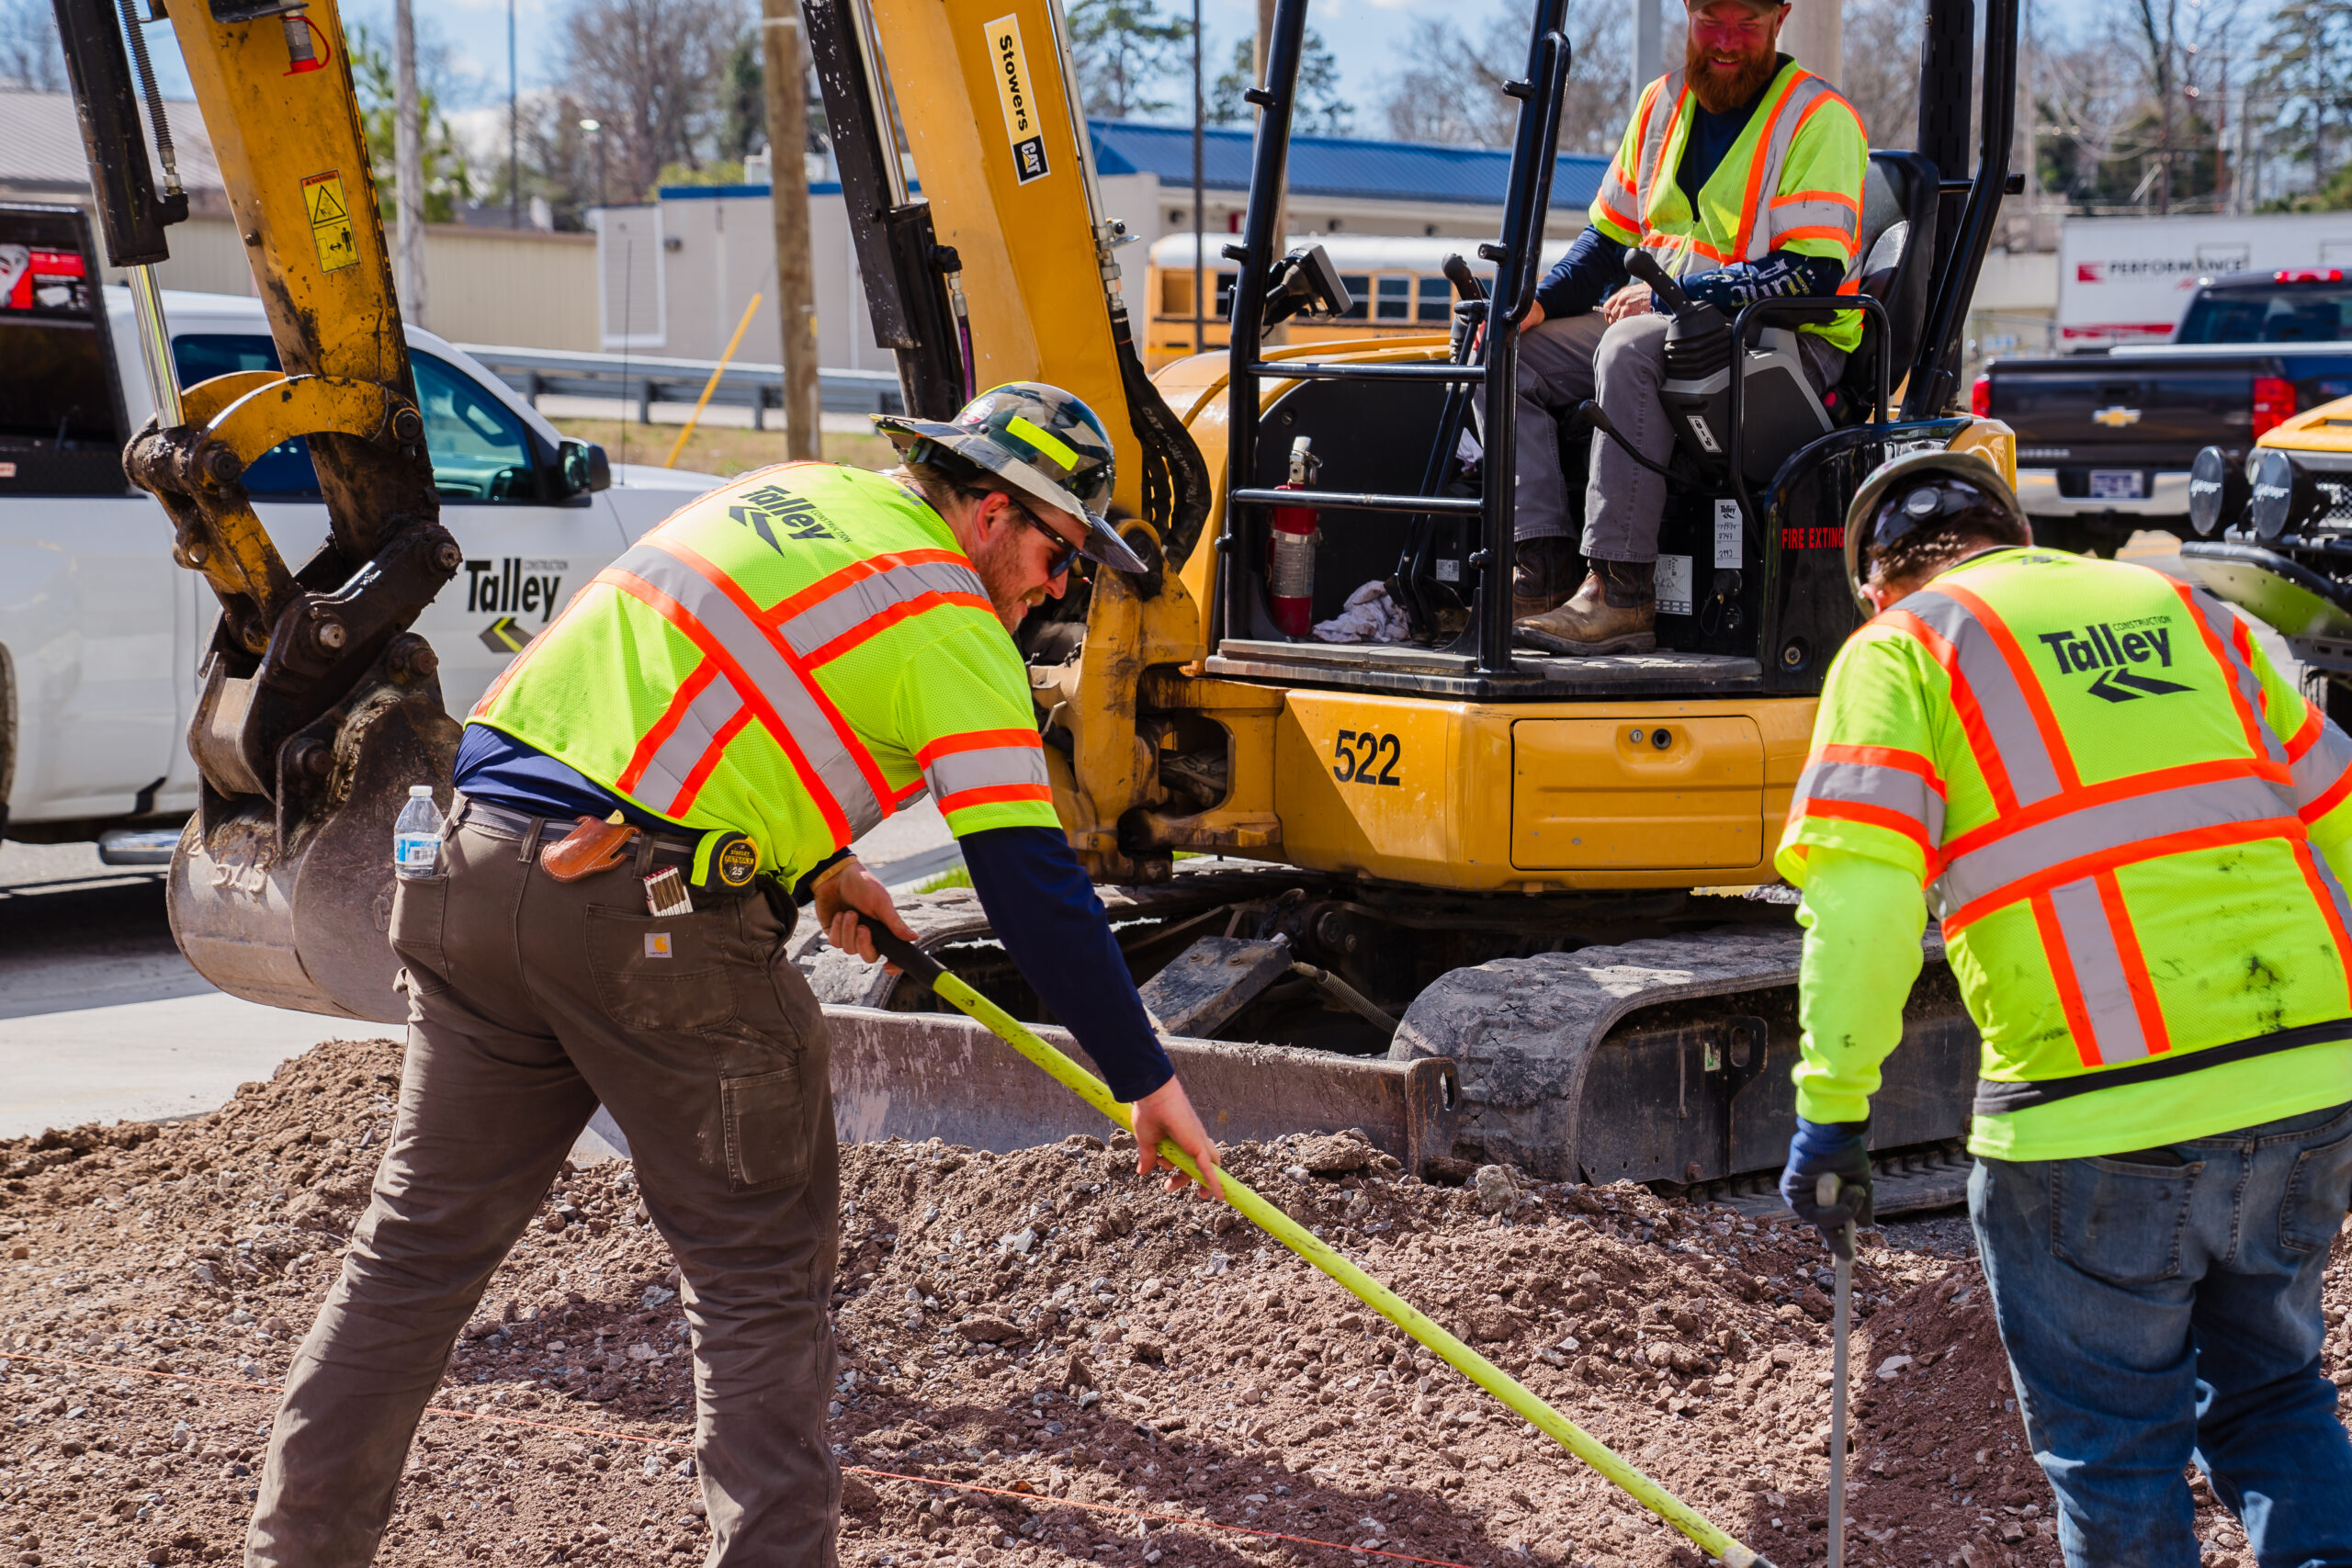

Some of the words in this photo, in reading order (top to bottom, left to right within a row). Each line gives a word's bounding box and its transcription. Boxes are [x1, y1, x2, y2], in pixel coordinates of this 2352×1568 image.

[1000, 34, 1028, 131] Stowers
[1021, 141, 1042, 174] CAT
[2109, 258, 2243, 274] PERFORMANCE
[1142, 406, 1164, 430] CAT
[738, 485, 835, 539] Talley
[810, 509, 853, 543] CONSTRUCTION
[1720, 505, 1736, 514] Talley
[1781, 527, 1804, 549] FIRE
[1809, 526, 1844, 548] EXTING
[465, 558, 560, 623] Talley
[2113, 615, 2173, 631] CONSTRUCTION
[2038, 623, 2172, 674] Talley
[1333, 728, 1401, 786] 522
